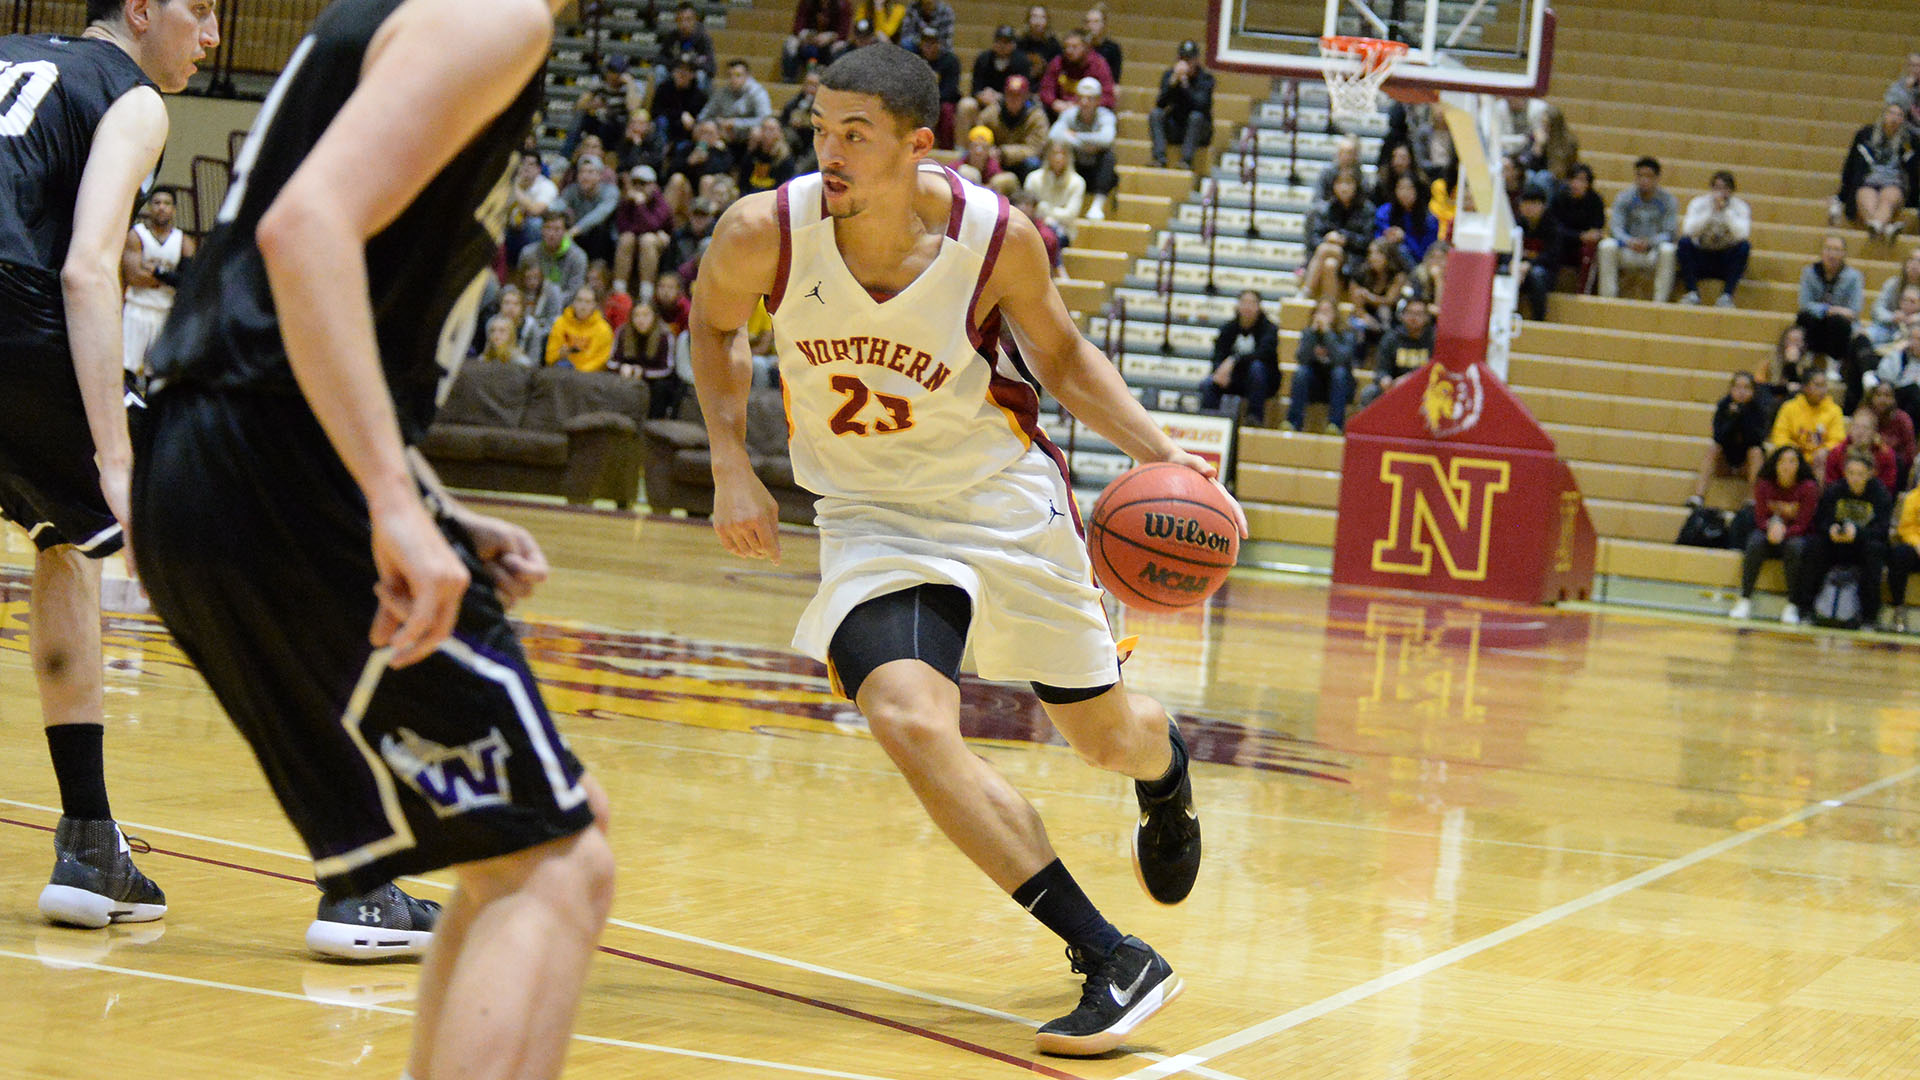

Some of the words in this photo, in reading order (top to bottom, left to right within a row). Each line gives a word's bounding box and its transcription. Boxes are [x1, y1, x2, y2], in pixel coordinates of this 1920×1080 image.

[795, 336, 952, 393] NORTHERN
[828, 373, 916, 438] 23
[1144, 511, 1231, 556] Wilson
[1371, 451, 1511, 581] N
